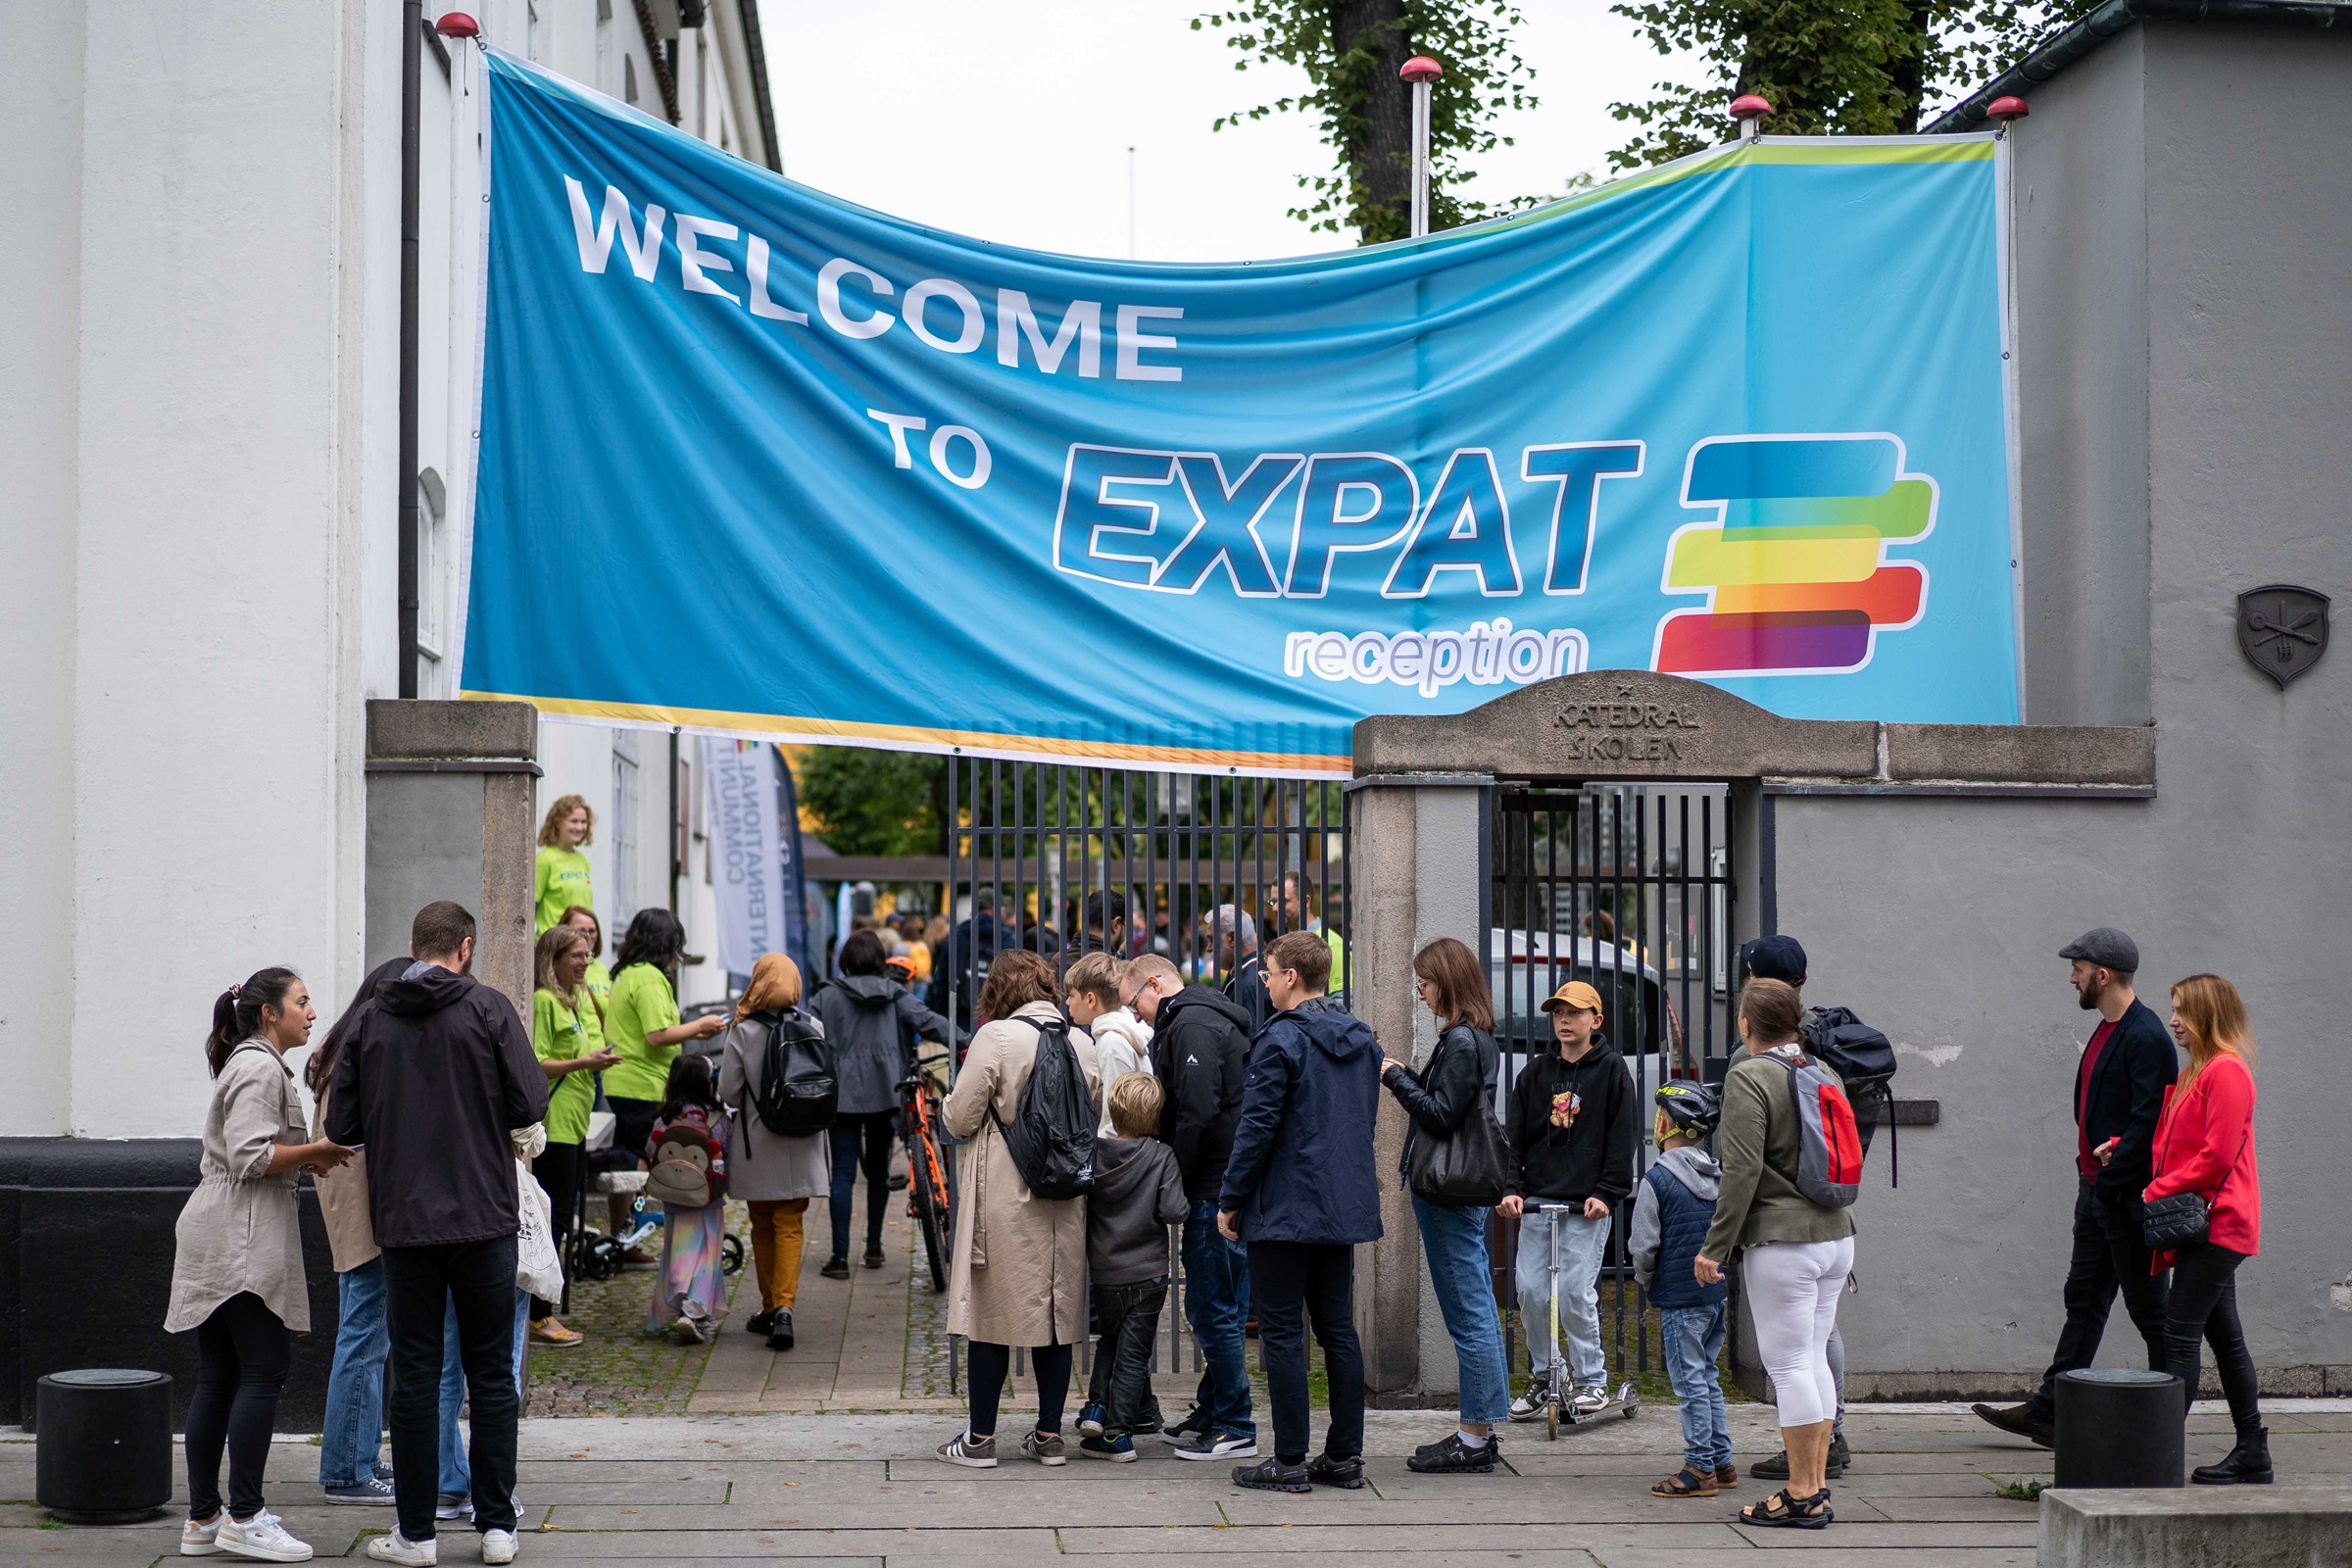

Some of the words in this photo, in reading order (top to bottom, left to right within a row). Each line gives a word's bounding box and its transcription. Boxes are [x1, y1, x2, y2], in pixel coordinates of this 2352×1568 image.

[564, 173, 1185, 382] WELCOME
[866, 408, 992, 490] TO
[1053, 439, 1646, 599] EXPAT
[1285, 618, 1588, 697] reception
[1553, 702, 1700, 729] KATEDRAL
[1568, 736, 1684, 760] SKOLEN
[1655, 1086, 1691, 1096] MET
